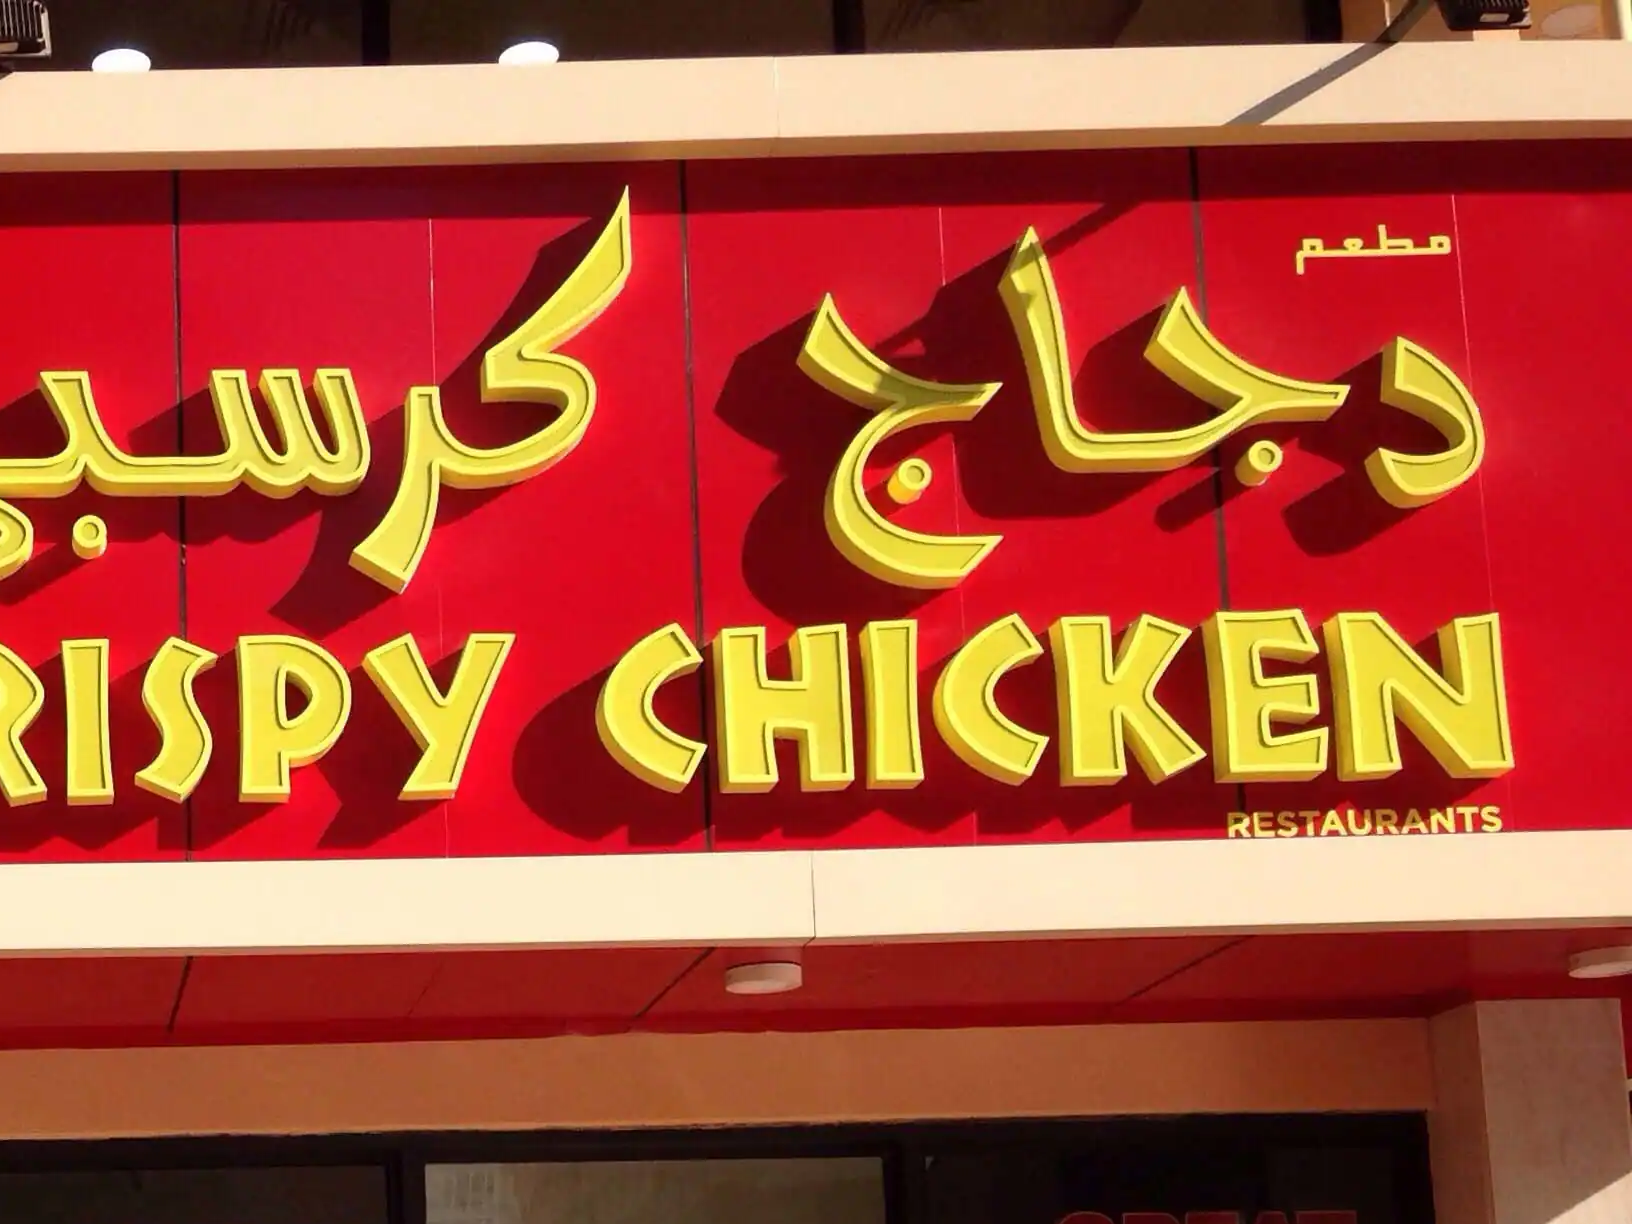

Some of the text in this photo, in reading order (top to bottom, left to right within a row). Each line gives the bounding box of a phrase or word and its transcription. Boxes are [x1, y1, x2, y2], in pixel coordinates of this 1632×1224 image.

[1296, 224, 1451, 275] مطعم
[797, 226, 1486, 588] دجاج
[596, 608, 1515, 793] CHICKEN
[1227, 805, 1503, 838] RESTAURANTS
